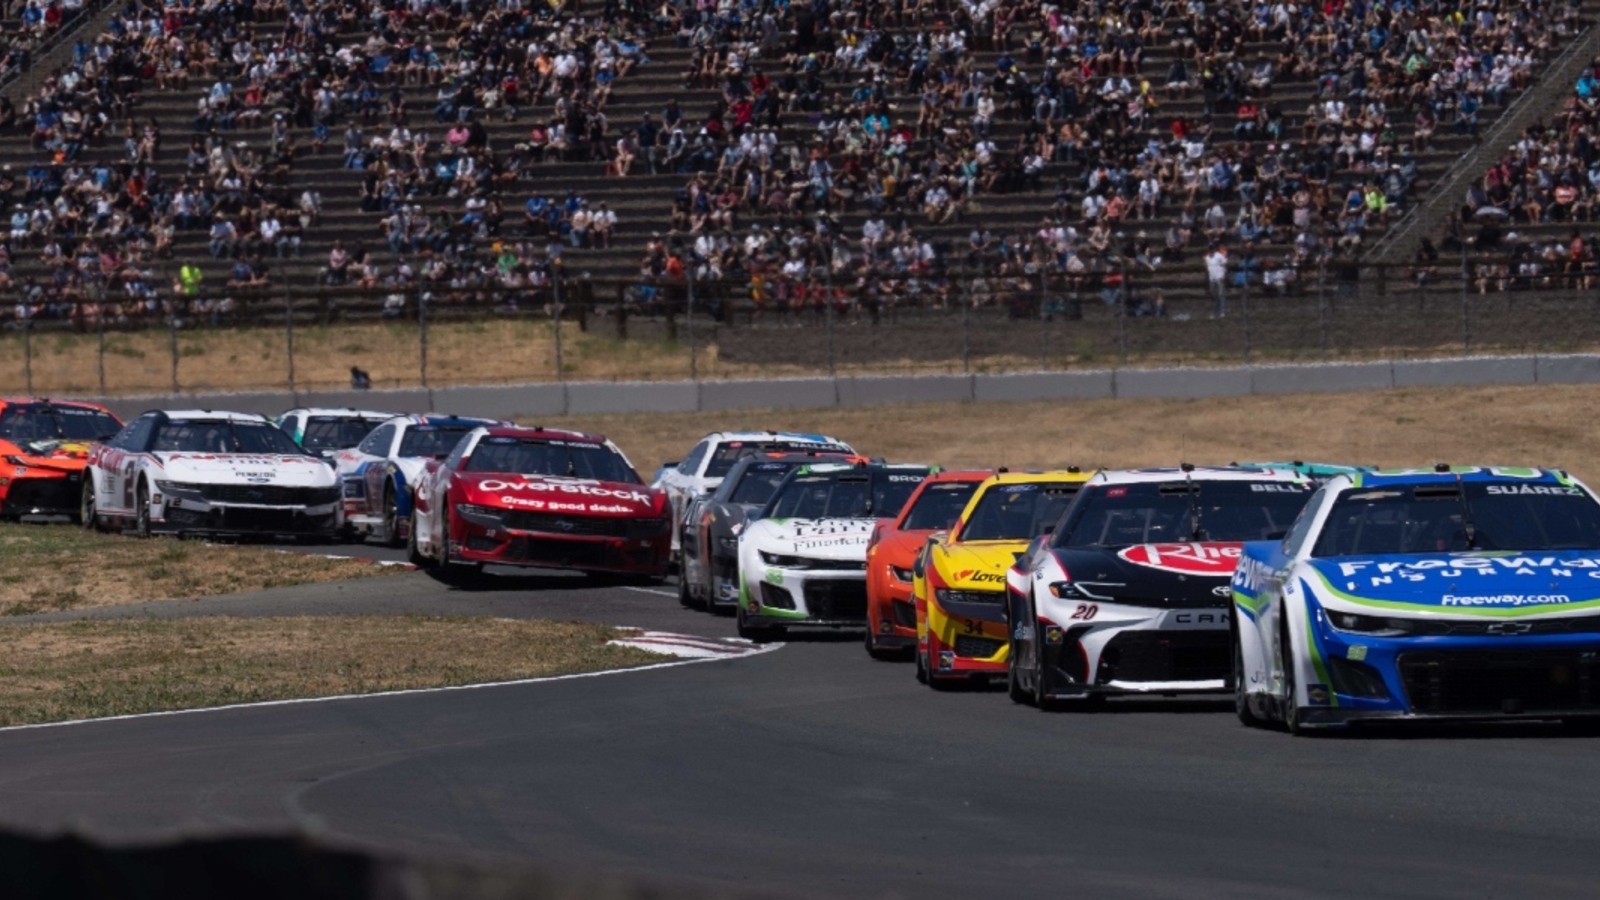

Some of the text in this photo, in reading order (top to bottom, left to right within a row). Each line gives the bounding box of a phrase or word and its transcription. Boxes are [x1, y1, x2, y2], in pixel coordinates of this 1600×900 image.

[479, 479, 651, 506] Overstock
[1250, 483, 1303, 493] BELL
[1486, 483, 1581, 496] SUÁREZ
[502, 496, 633, 513] Crazy good deals.
[1441, 594, 1570, 609] Freeway.com
[1069, 603, 1098, 620] 20
[964, 619, 983, 635] 34
